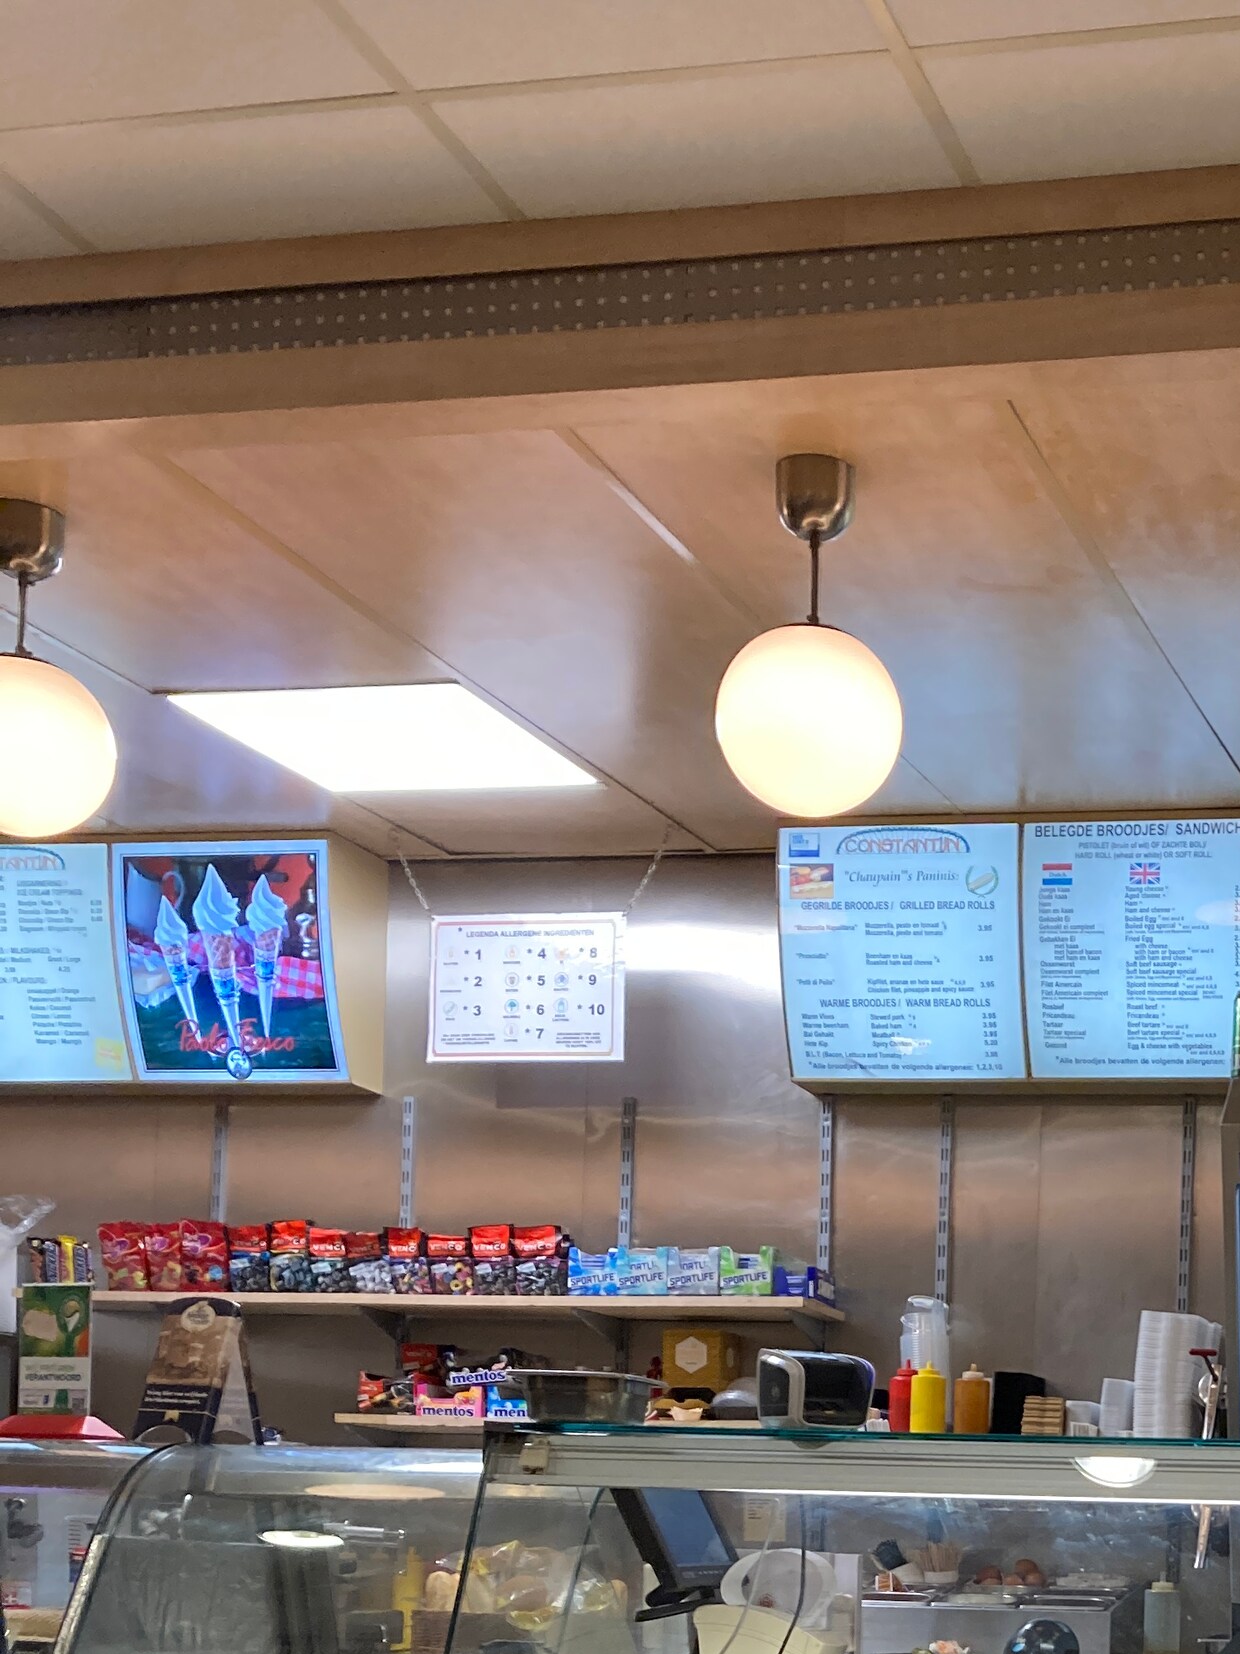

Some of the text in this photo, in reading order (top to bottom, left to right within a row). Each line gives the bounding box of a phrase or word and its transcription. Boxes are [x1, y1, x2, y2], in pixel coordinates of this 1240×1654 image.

[1034, 825, 1093, 837] BELEGDE
[1097, 824, 1169, 836] BROODJES/
[801, 901, 843, 910] GEGRILDE
[844, 901, 889, 910] BROODJES
[900, 901, 935, 910] GRILLED
[936, 900, 966, 910] BREAD
[968, 900, 995, 910] ROLLS
[475, 950, 482, 960] 1
[537, 948, 546, 958] 4
[589, 948, 598, 958] 8
[474, 976, 482, 986] 2
[536, 976, 546, 986] 5
[588, 974, 597, 985] 9
[820, 1000, 850, 1008] WARME
[906, 999, 932, 1007] WARM
[933, 999, 962, 1007] BREAD
[964, 999, 990, 1007] ROLLS
[473, 1006, 482, 1016] 3
[536, 1004, 545, 1015] 6
[588, 1004, 605, 1015] 10
[536, 1028, 544, 1038] 7
[1128, 1042, 1140, 1050] Egg
[474, 1242, 506, 1250] VENCO
[519, 1242, 554, 1251] VENCO
[570, 1273, 616, 1286] SPORTLIFE
[619, 1272, 664, 1286] SPORTLIFE
[670, 1272, 716, 1286] SPORTLIFE
[723, 1272, 768, 1286] SPORTLIFE
[452, 1370, 506, 1385] mentos
[422, 1407, 474, 1417] mentos
